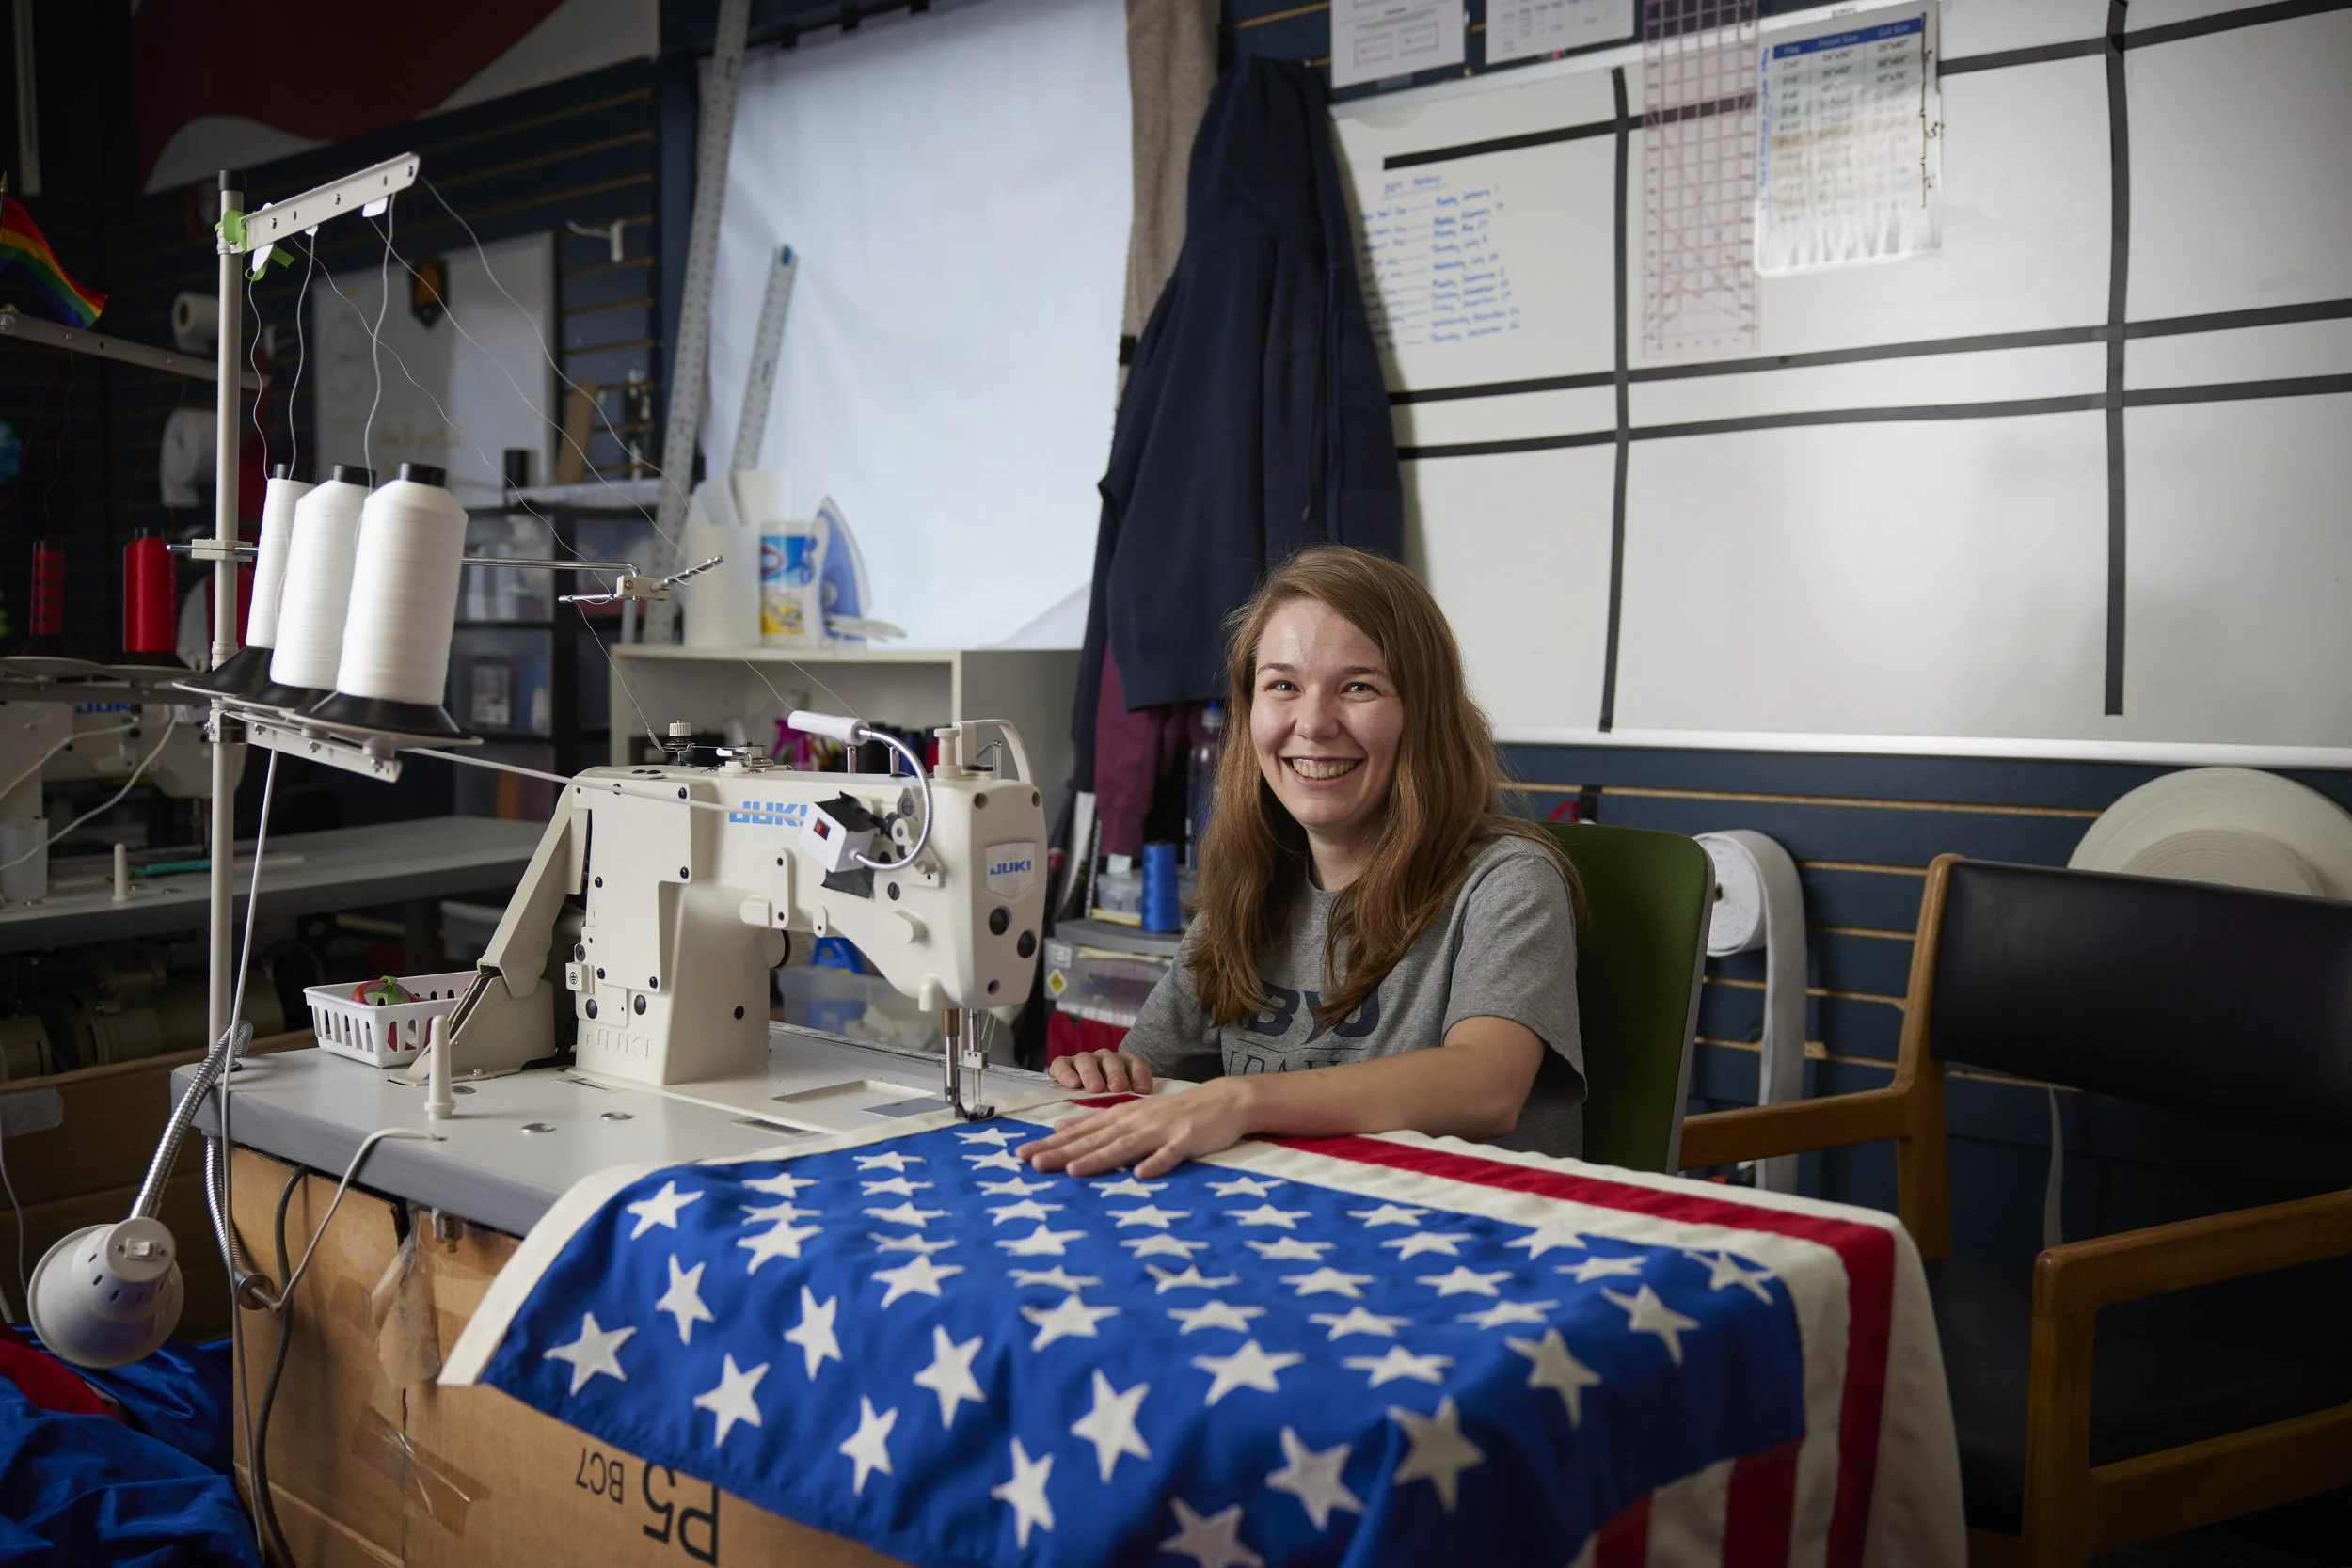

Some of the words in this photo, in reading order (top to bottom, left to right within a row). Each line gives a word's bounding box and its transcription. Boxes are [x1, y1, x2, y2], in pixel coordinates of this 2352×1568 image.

[728, 800, 809, 828] JUKI
[989, 859, 1032, 876] JUKI
[575, 1447, 625, 1505] BC7
